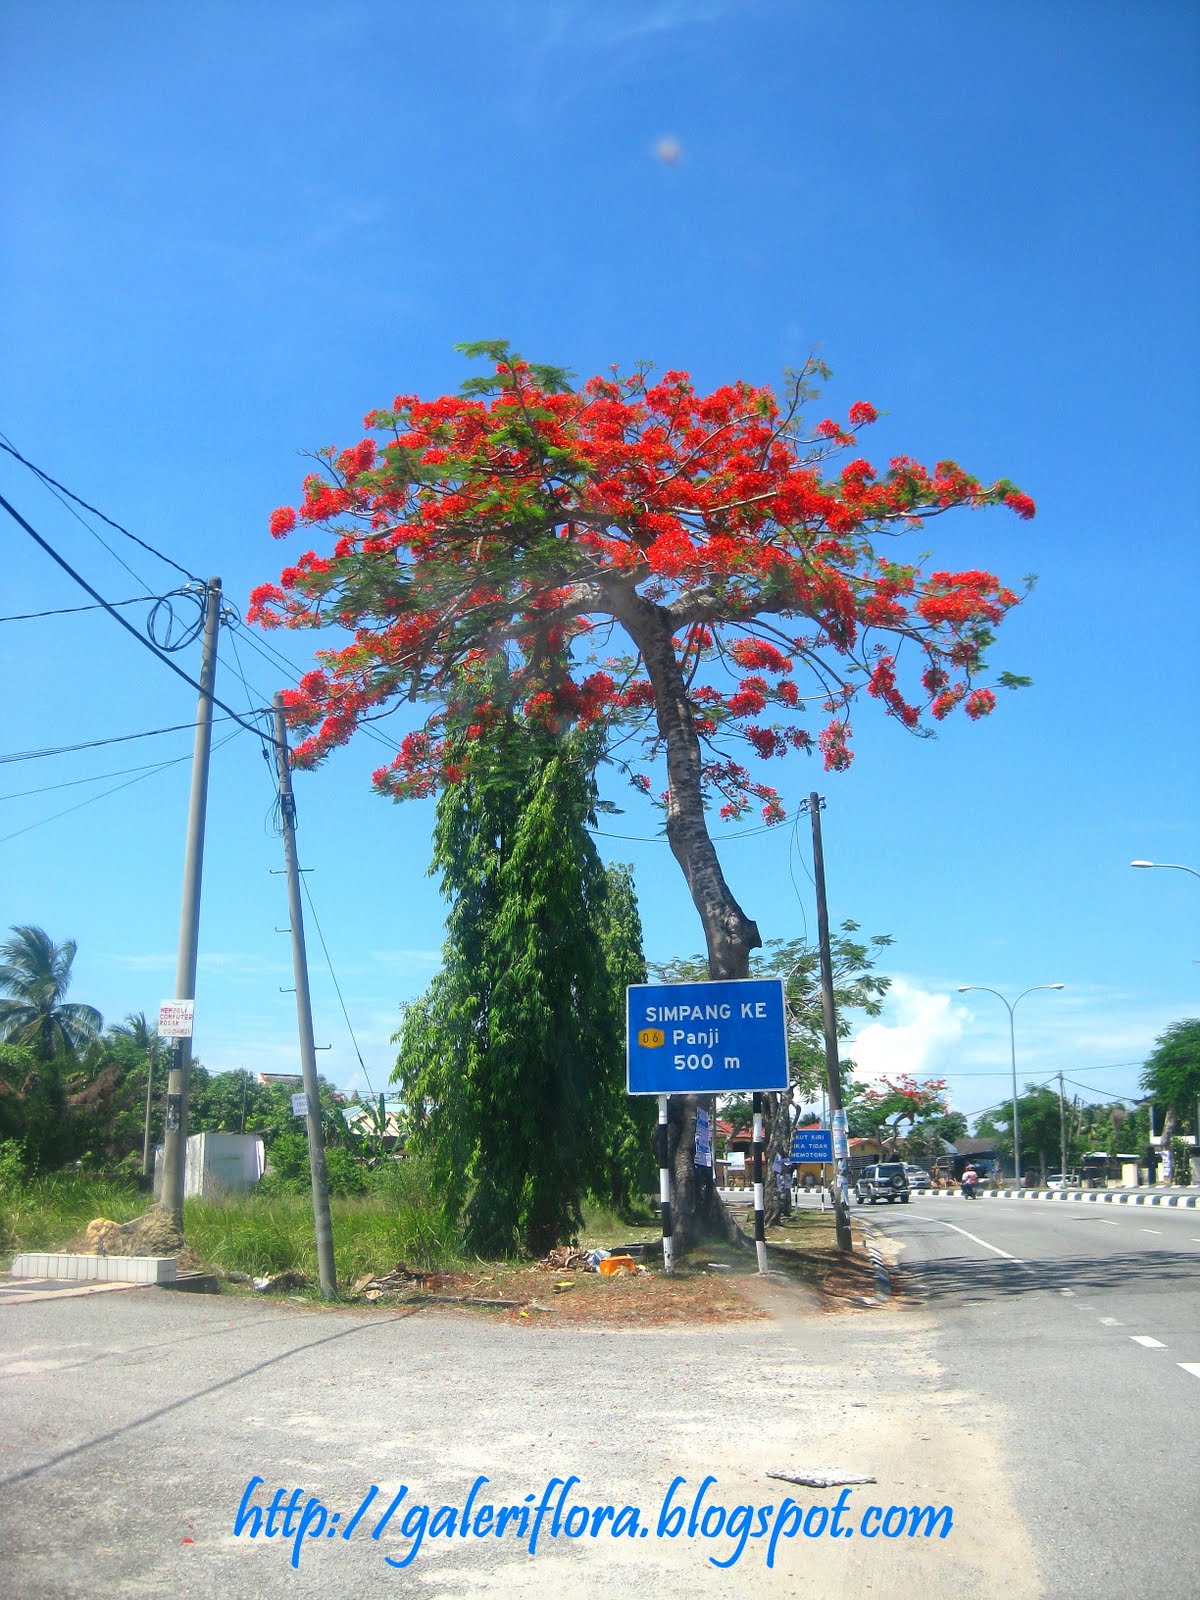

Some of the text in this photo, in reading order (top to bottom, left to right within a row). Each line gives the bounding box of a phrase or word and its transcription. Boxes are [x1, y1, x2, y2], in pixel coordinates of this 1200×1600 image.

[645, 1002, 768, 1023] SIMPANG KE
[672, 1028, 719, 1049] Panji
[674, 1053, 740, 1071] 500 m
